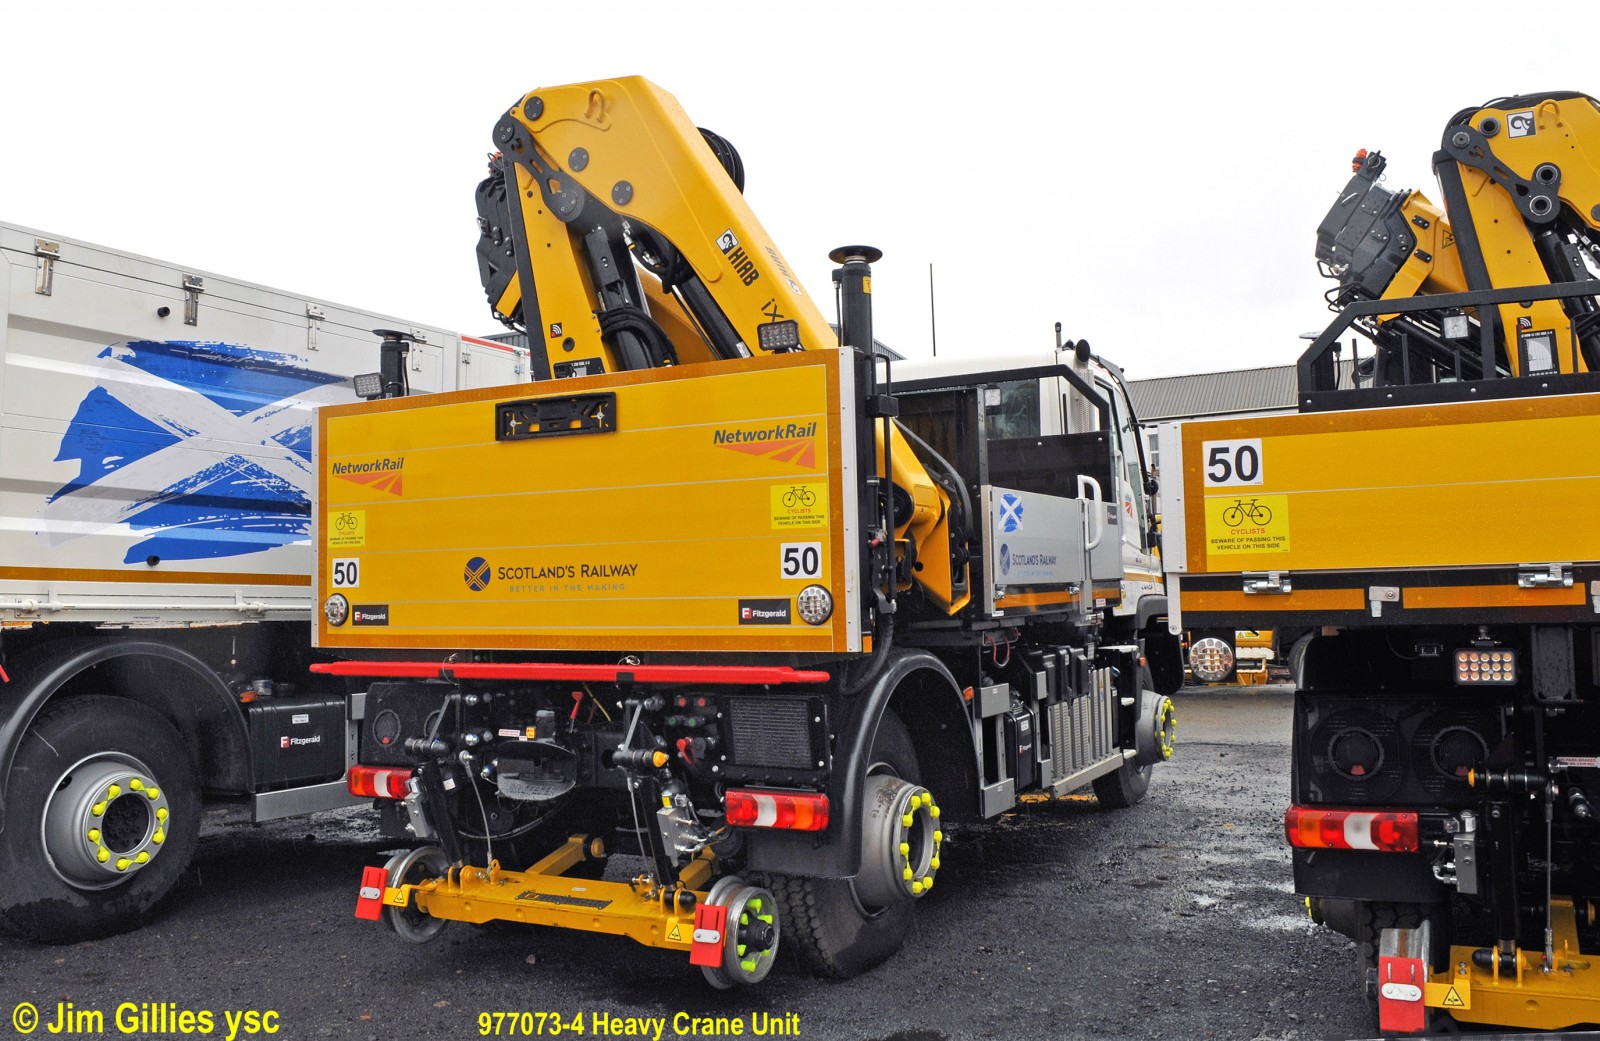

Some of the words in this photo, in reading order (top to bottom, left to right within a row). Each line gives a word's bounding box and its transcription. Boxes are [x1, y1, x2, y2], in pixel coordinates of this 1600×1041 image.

[727, 246, 760, 287] HIAB
[713, 422, 817, 445] NetworkRail
[332, 457, 404, 475] NetworkRail
[1208, 445, 1259, 483] 50
[1231, 527, 1266, 535] CYCLISTS
[783, 546, 819, 576] 50
[333, 561, 358, 586] 50
[498, 565, 575, 580] SCOTLAND'S
[580, 563, 638, 578] RAILWAY
[509, 585, 545, 593] BETTER
[564, 584, 582, 592] THE
[587, 583, 625, 591] MAKING
[362, 612, 386, 621] Fitzgerald
[752, 609, 787, 619] Fitzgerald
[290, 735, 321, 746] Fitzgerald
